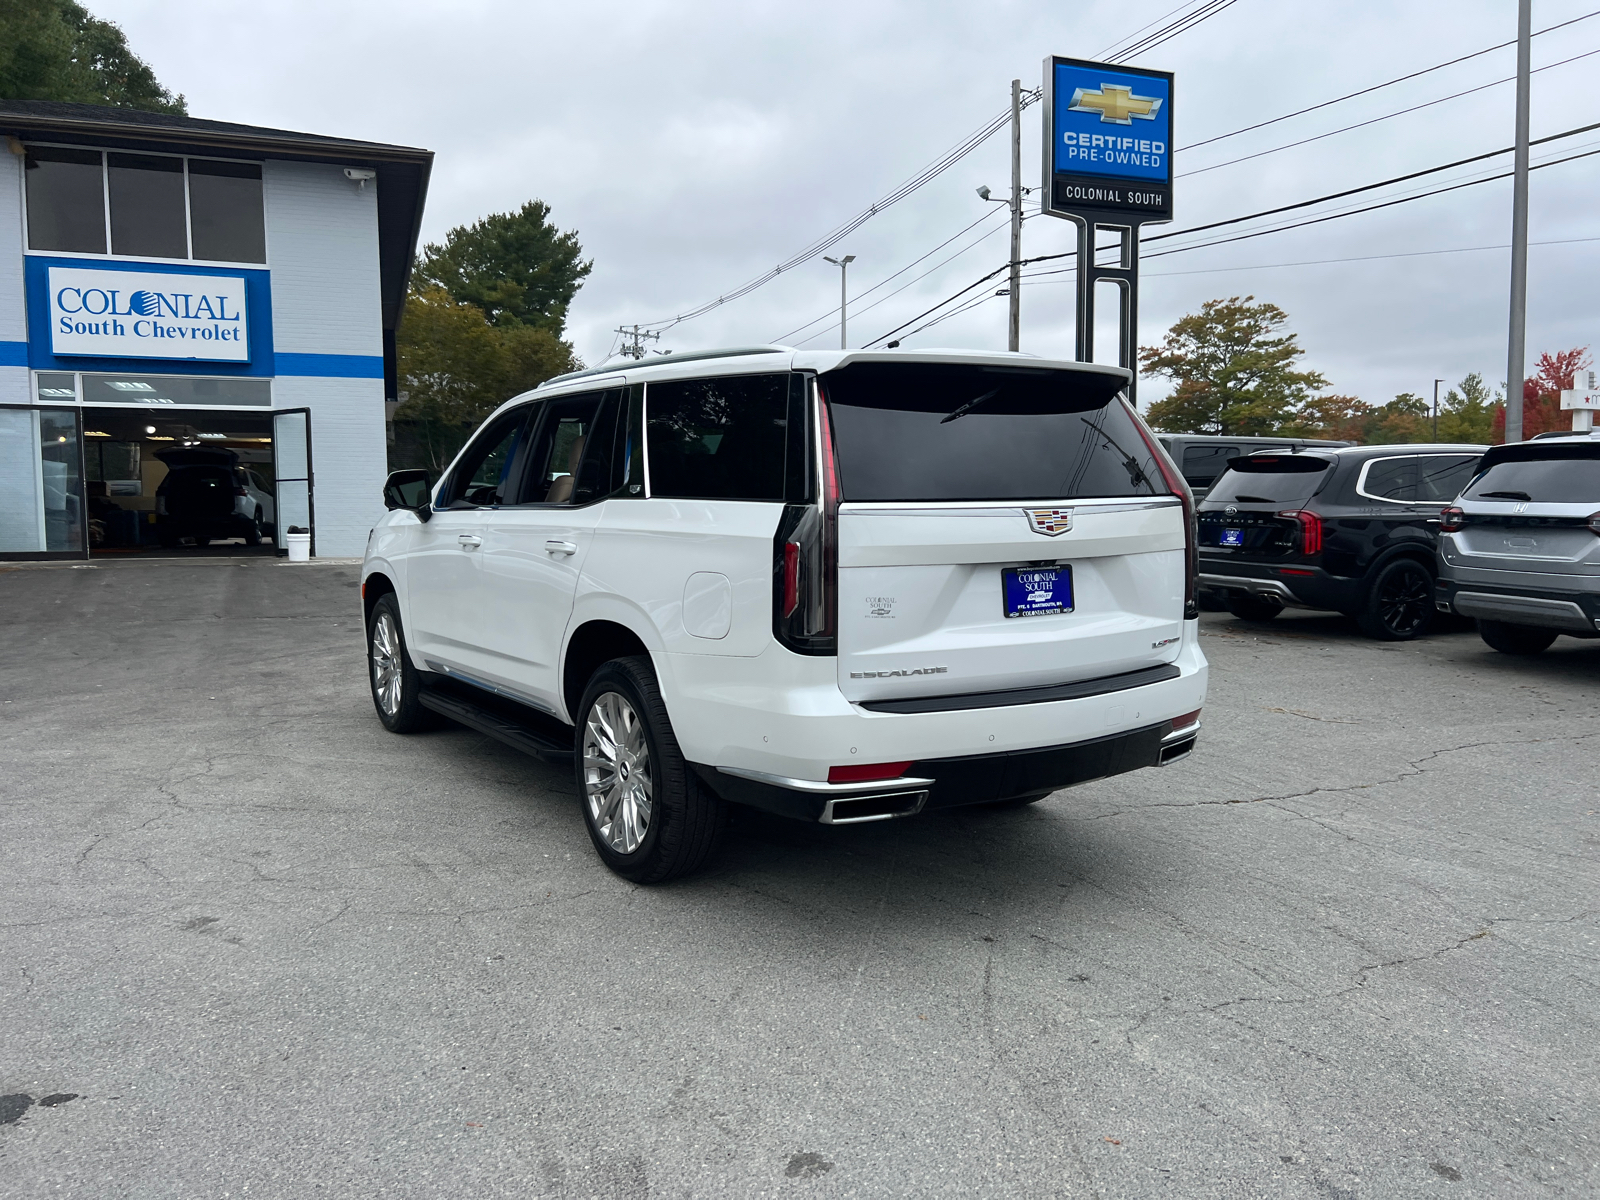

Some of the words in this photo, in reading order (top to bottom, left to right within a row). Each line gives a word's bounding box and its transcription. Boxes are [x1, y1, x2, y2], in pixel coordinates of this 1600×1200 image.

[1063, 131, 1165, 154] CERTIFIED
[1068, 147, 1160, 168] PRE-OWNED
[1066, 186, 1121, 202] COLONIAL
[1127, 191, 1162, 206] SOUTH
[57, 287, 240, 321] COLONIAL
[60, 316, 126, 336] South
[133, 320, 240, 341] Chevrolet
[1018, 572, 1058, 583] COLONIAL
[1026, 582, 1052, 591] SOUTH
[850, 665, 948, 679] ESCALADE
